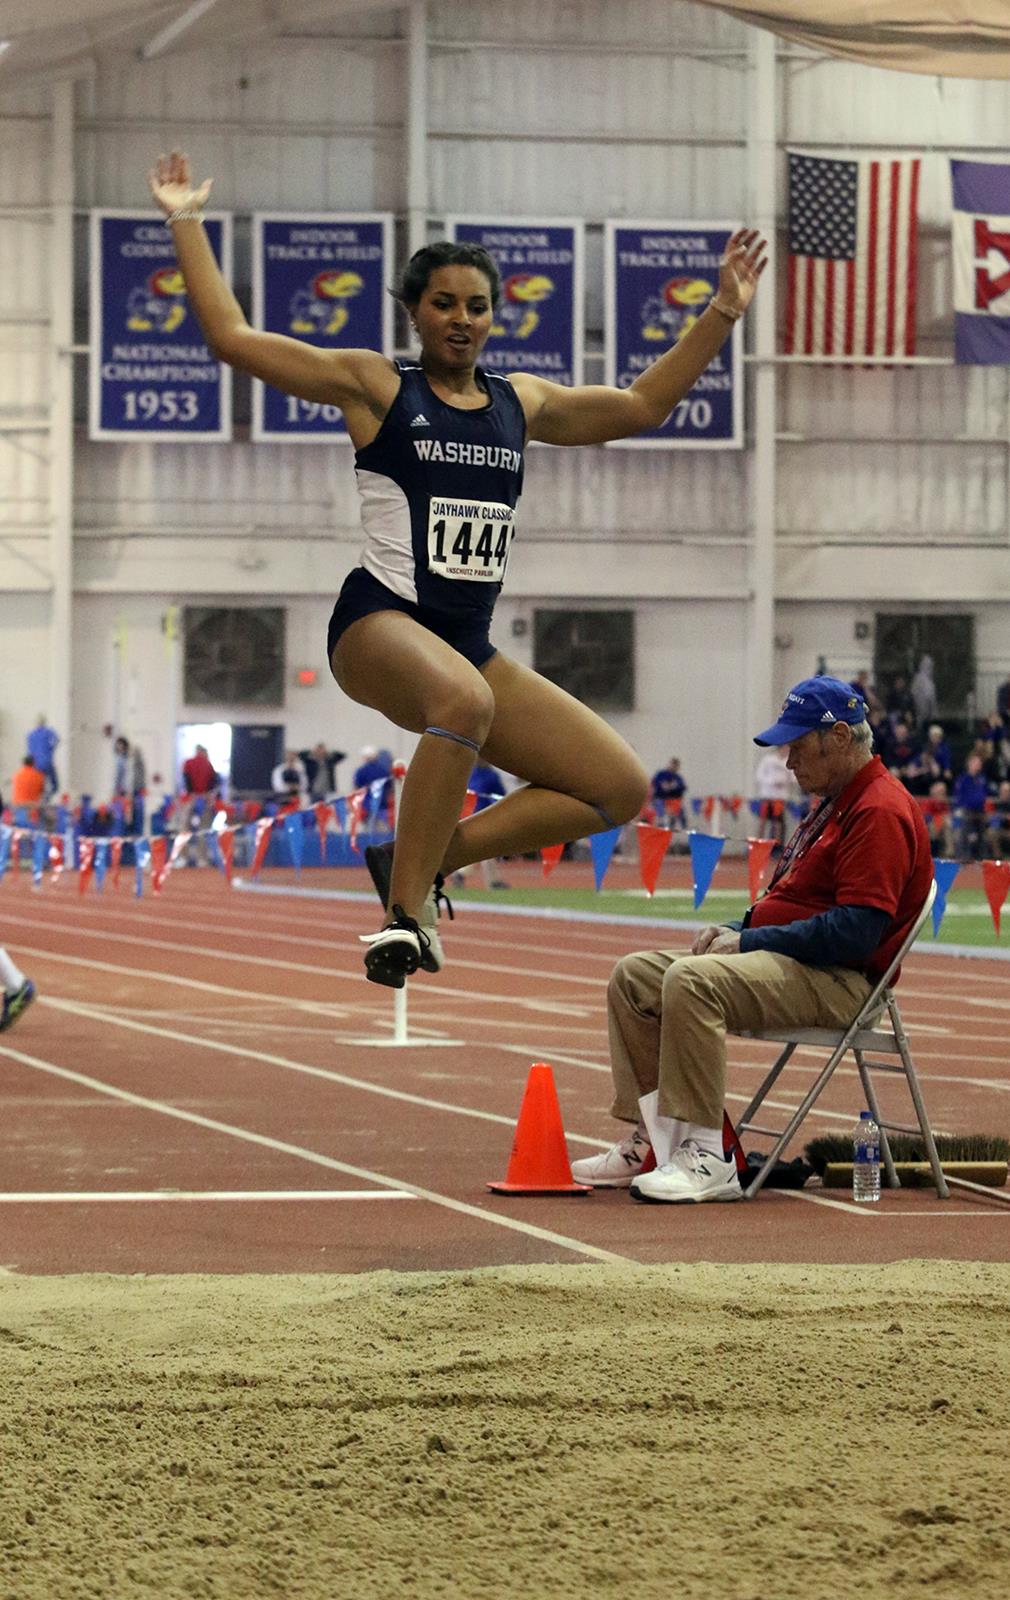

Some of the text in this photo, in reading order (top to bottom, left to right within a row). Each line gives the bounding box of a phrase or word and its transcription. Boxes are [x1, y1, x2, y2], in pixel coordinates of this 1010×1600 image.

[290, 231, 358, 243] INDOOR
[482, 234, 548, 247] INDOOR
[641, 237, 708, 251] INDOOR
[268, 247, 318, 260] TRACK
[336, 247, 382, 260] FIELD
[528, 251, 574, 264] FIELD
[619, 252, 669, 267] TRACK
[687, 255, 721, 269] FIEL
[112, 346, 210, 361] NATIONAL
[102, 366, 218, 382] CHAMPIONS
[122, 391, 198, 421] 1953
[287, 397, 343, 422] 196
[675, 399, 712, 429] 70
[413, 440, 521, 473] WASHBURN
[433, 503, 513, 521] JAYHAWK CLASSIC
[432, 519, 515, 567] 1444
